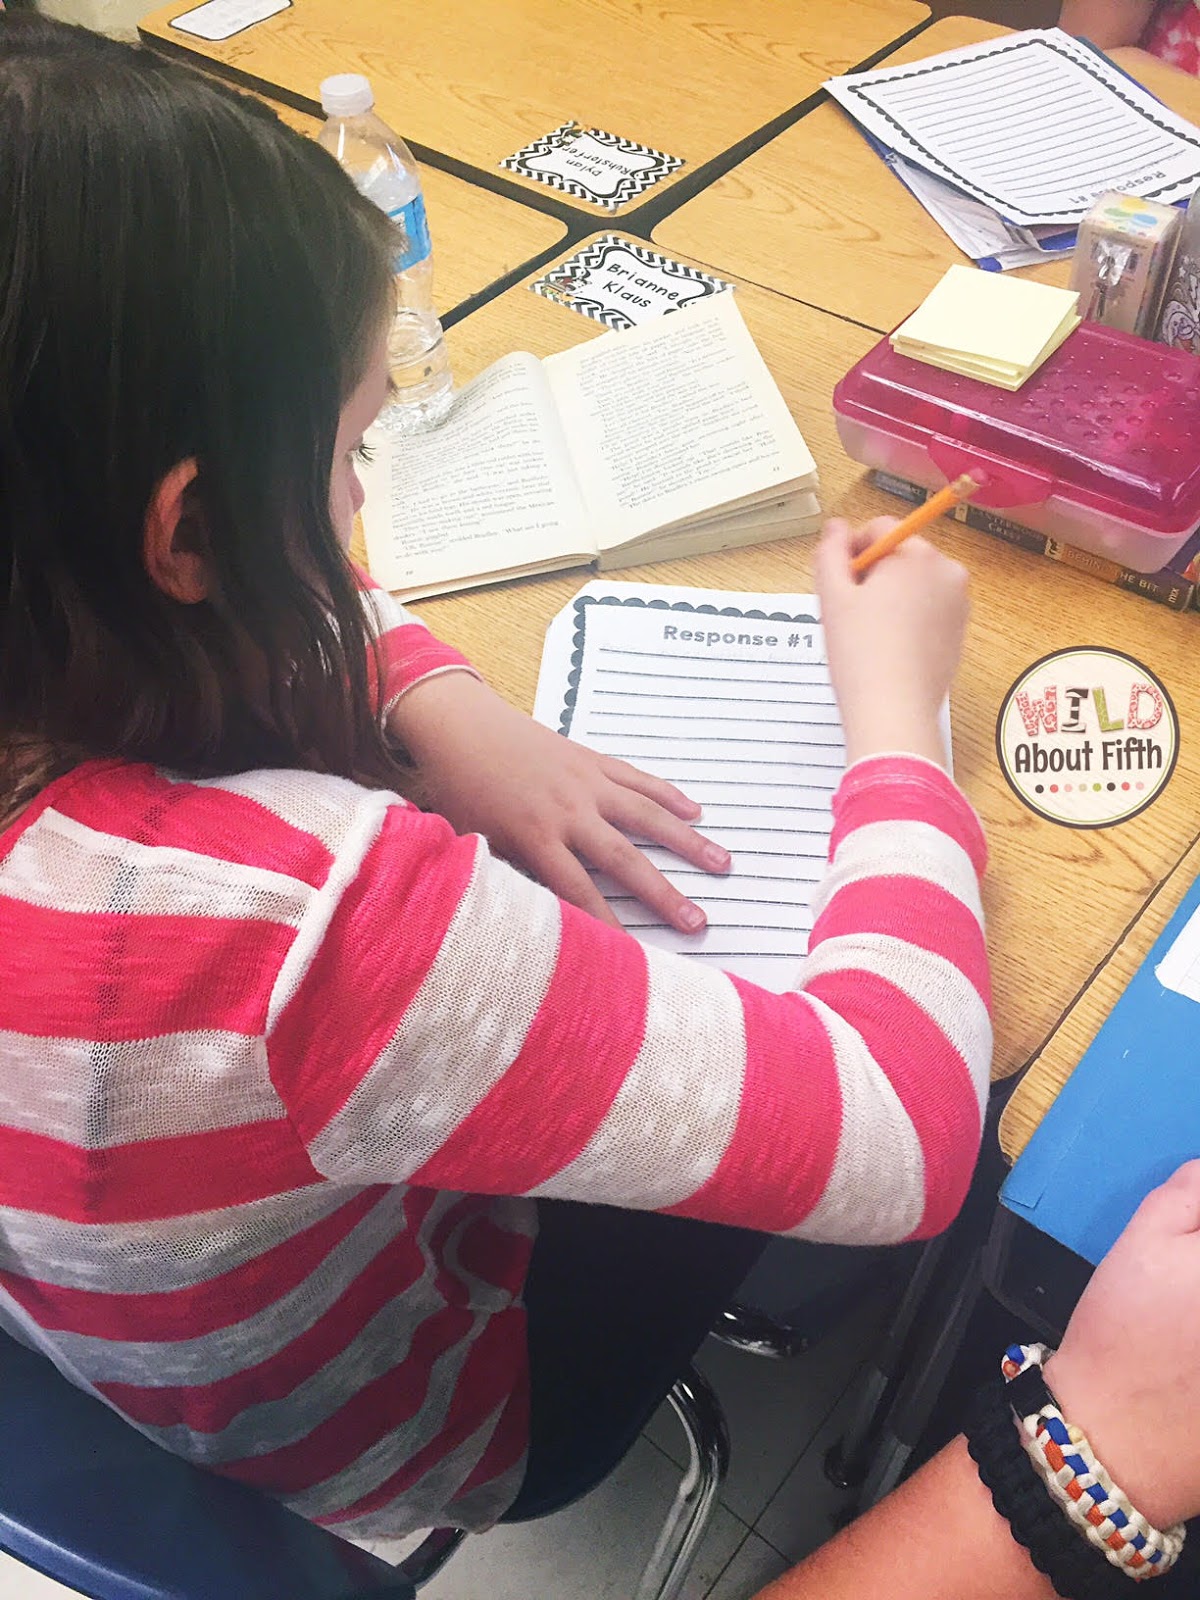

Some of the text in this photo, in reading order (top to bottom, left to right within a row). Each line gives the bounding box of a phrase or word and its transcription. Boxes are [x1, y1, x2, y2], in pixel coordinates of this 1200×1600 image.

[566, 159, 602, 177] Dylan
[1089, 170, 1167, 198] Respoe
[602, 281, 651, 309] Klaus
[606, 263, 680, 301] Brianne
[1067, 550, 1110, 573] BEHIN
[1139, 579, 1160, 593] BIT
[663, 624, 815, 648] Response #1
